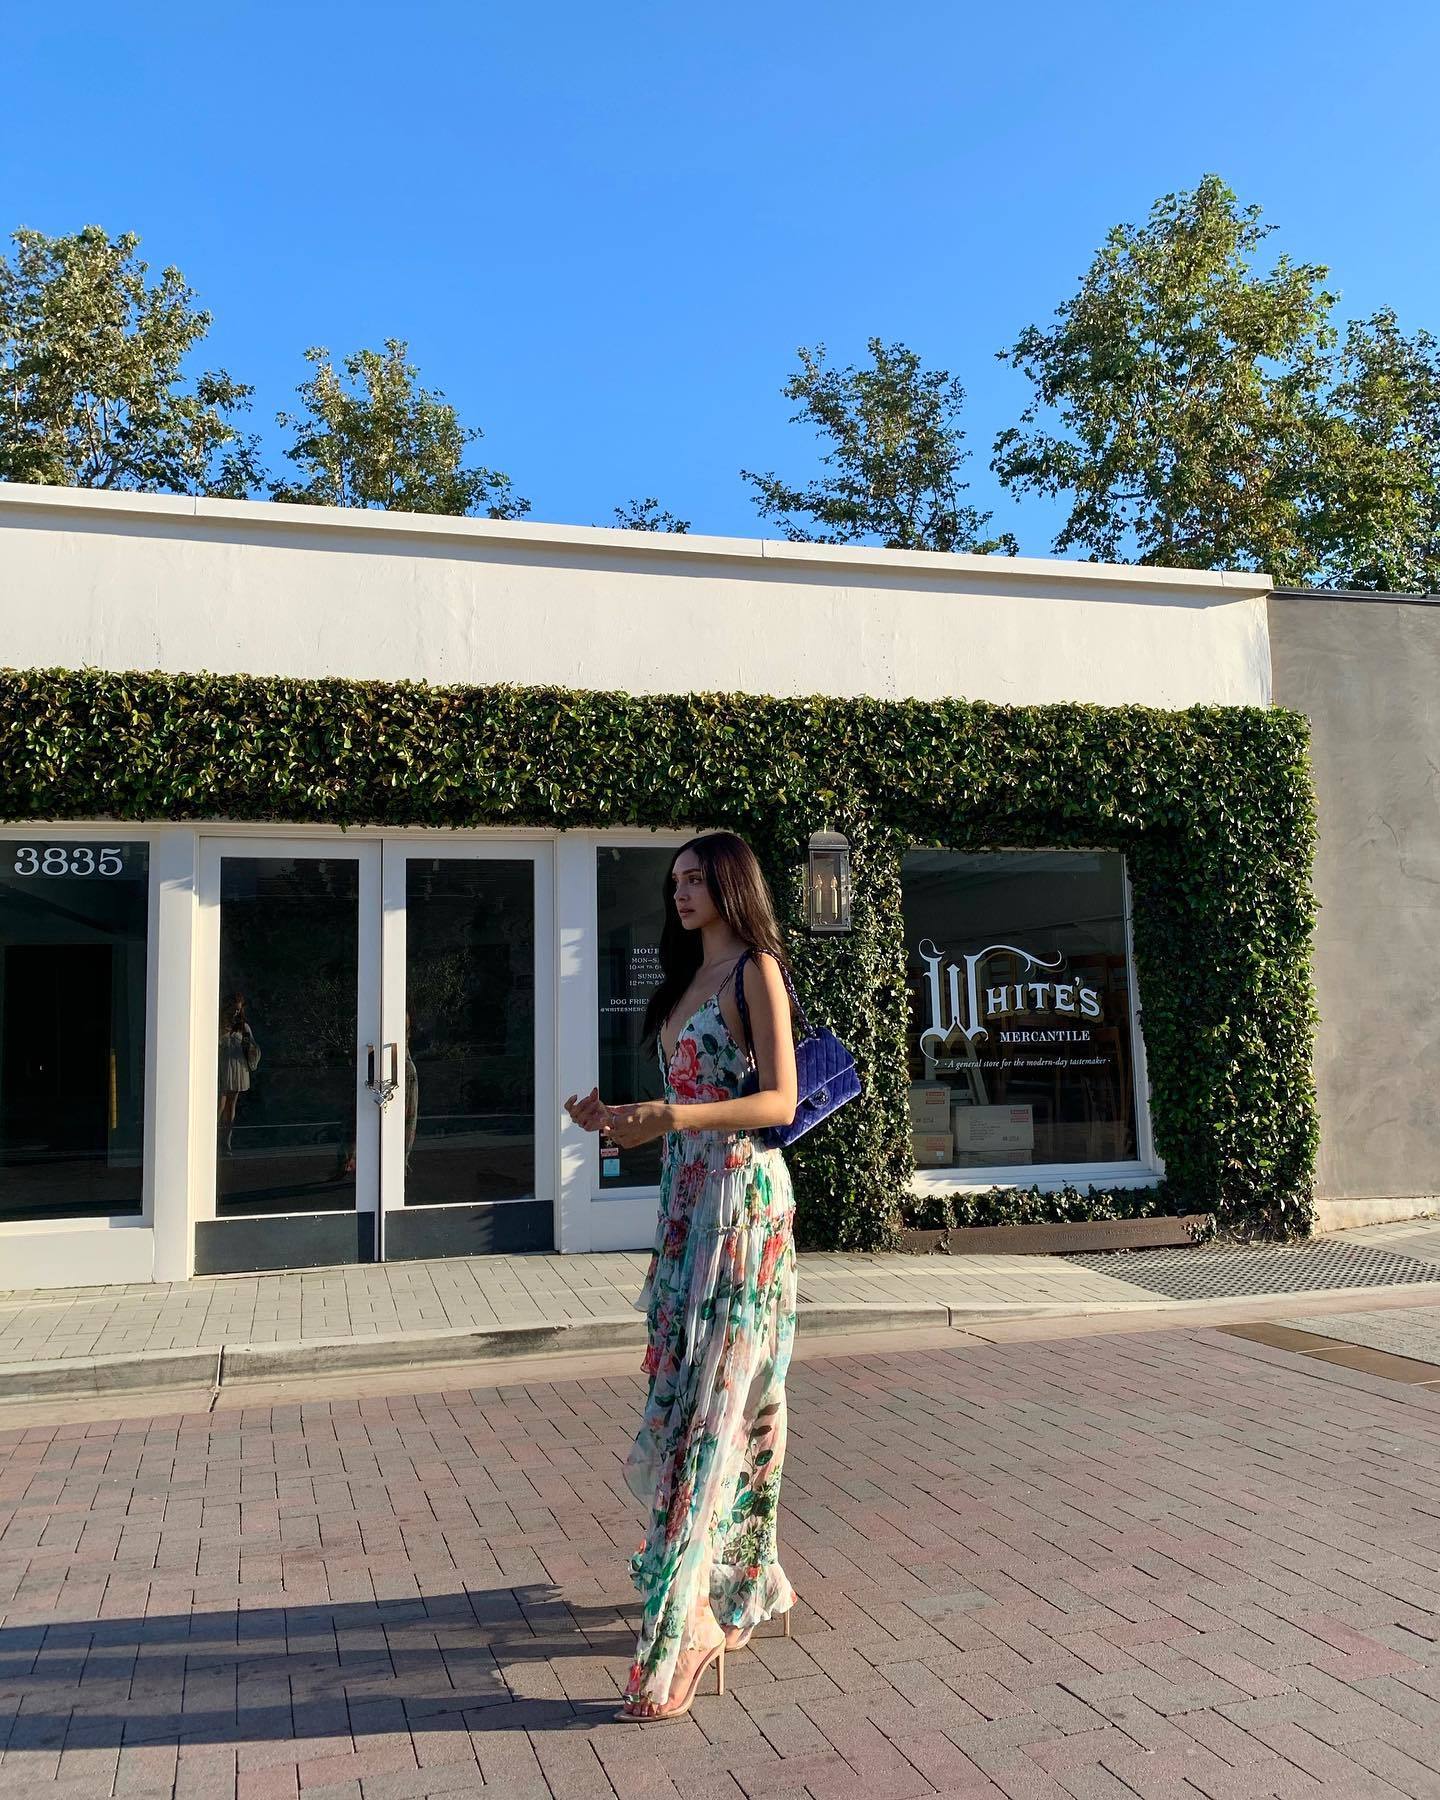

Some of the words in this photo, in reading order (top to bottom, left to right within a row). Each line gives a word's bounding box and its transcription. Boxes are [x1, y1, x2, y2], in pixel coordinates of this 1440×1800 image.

[14, 847, 123, 876] 3835
[610, 998, 628, 1006] DOG
[918, 938, 1101, 1067] WHITE'S
[1000, 1030, 1091, 1044] MERCANTILE
[955, 1058, 982, 1070] general
[1000, 1058, 1013, 1070] for
[1013, 1057, 1025, 1067] the
[1026, 1057, 1068, 1068] modern-day
[1069, 1056, 1107, 1065] tastemaker
